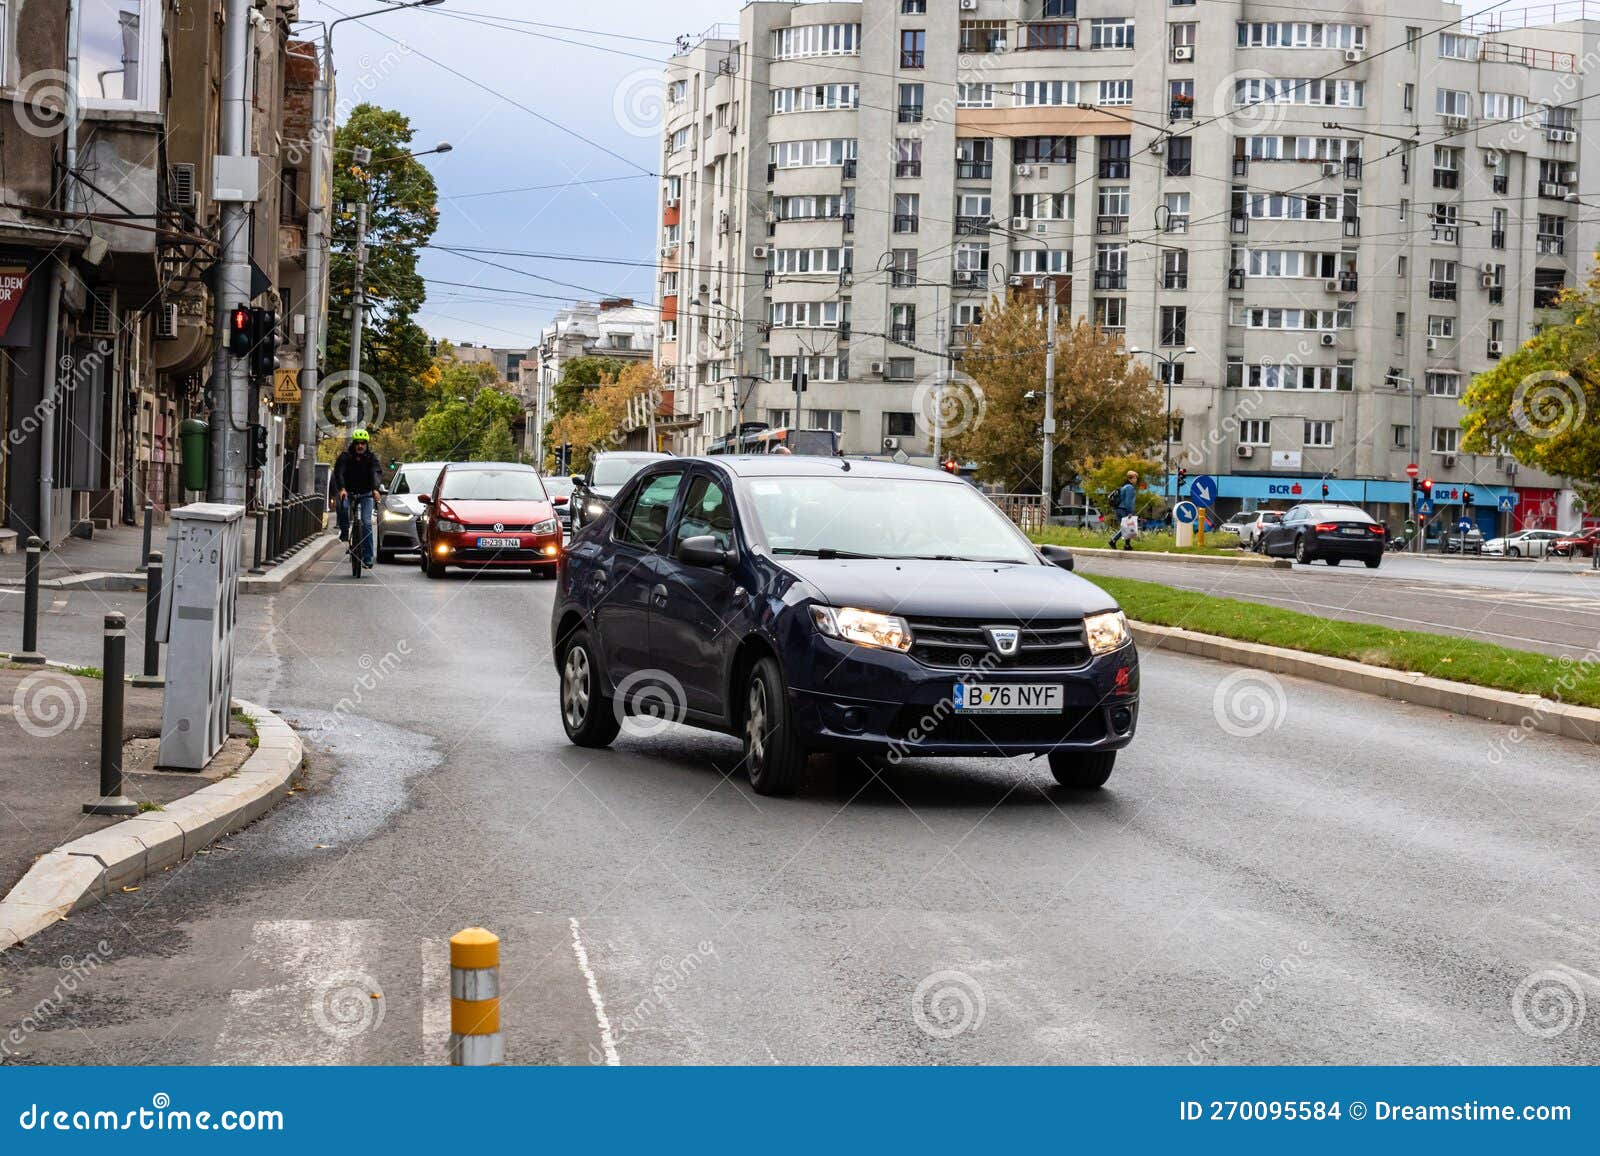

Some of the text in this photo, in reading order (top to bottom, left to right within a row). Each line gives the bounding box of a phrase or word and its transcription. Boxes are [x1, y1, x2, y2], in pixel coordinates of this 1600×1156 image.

[1269, 484, 1290, 494] BCR
[1435, 490, 1450, 499] BCR
[969, 687, 982, 706] B
[989, 687, 1011, 706] 76
[1018, 686, 1057, 706] NYF
